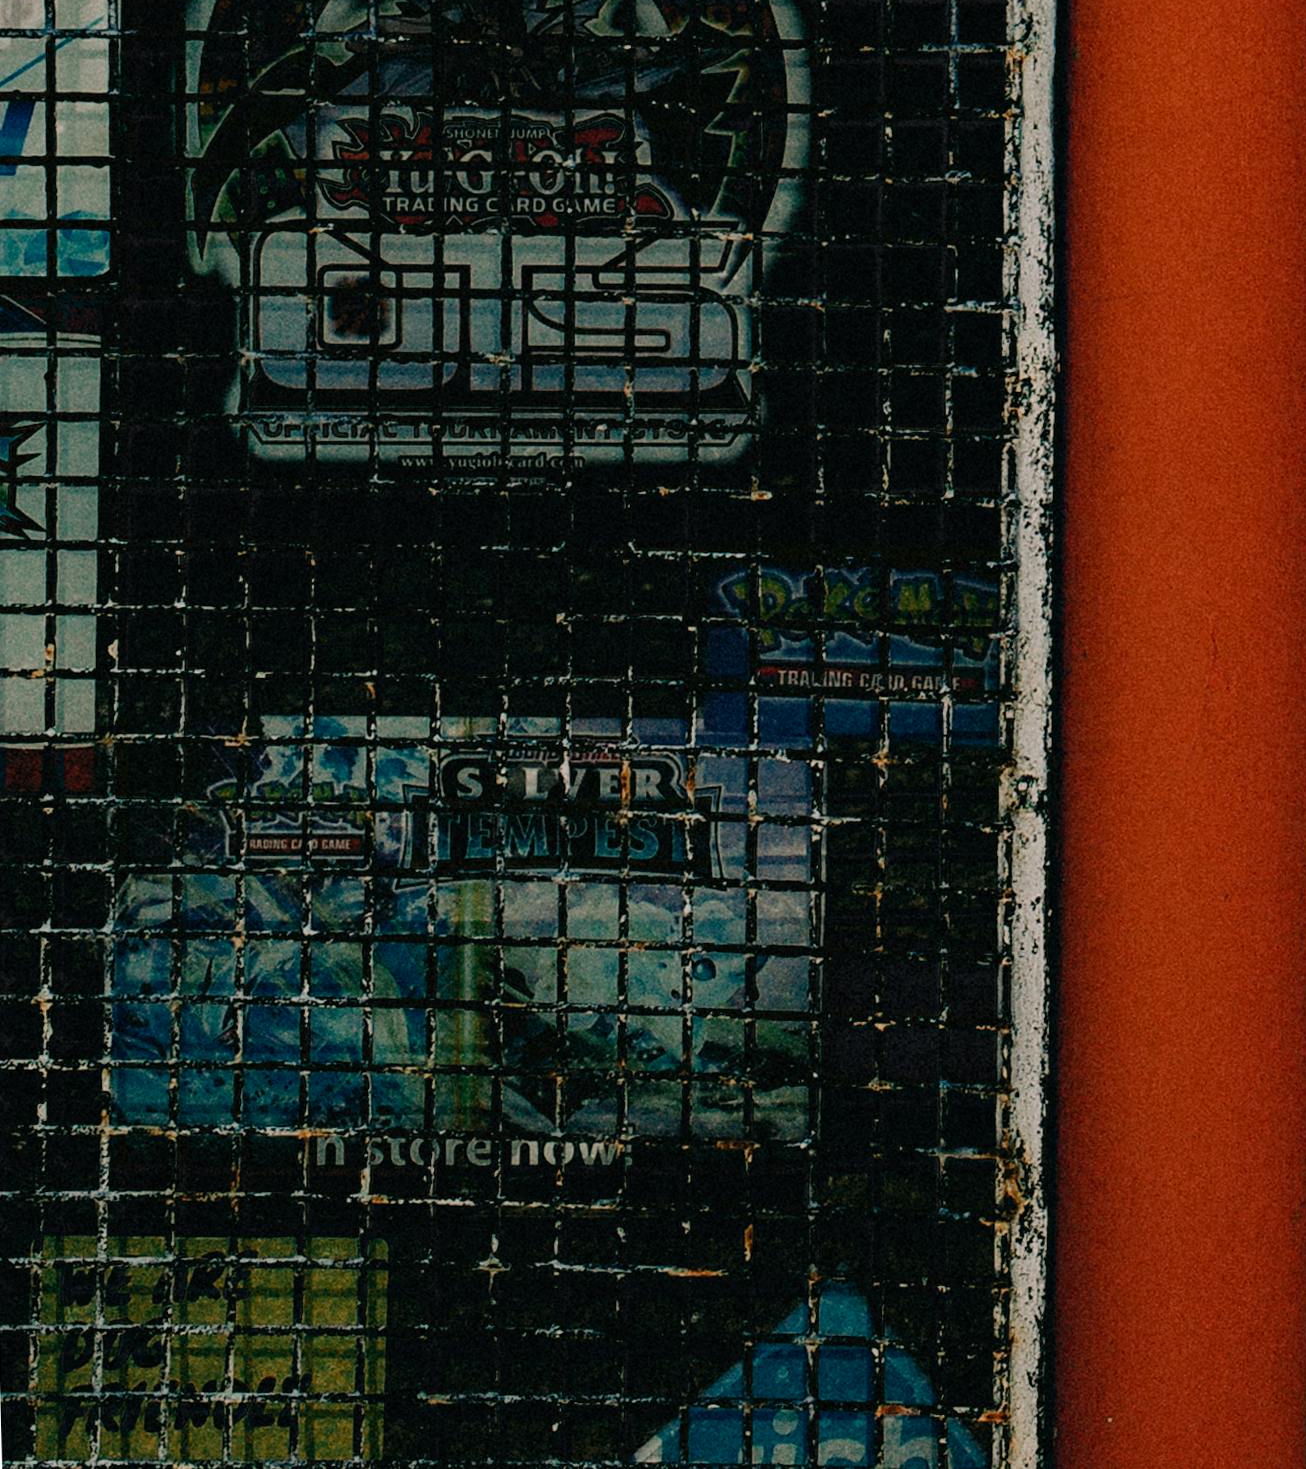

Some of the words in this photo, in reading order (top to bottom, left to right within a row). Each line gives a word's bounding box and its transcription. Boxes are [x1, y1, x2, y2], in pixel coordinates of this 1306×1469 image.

[445, 125, 508, 139] SHONE
[508, 126, 549, 140] JUMP
[378, 148, 621, 196] Yu-G-Oh!
[455, 766, 667, 800] SLVER
[244, 838, 288, 850] RADING
[290, 838, 318, 850] CAD
[320, 838, 352, 850] GAME
[432, 811, 692, 864] TEMPEST
[365, 1136, 492, 1167] store
